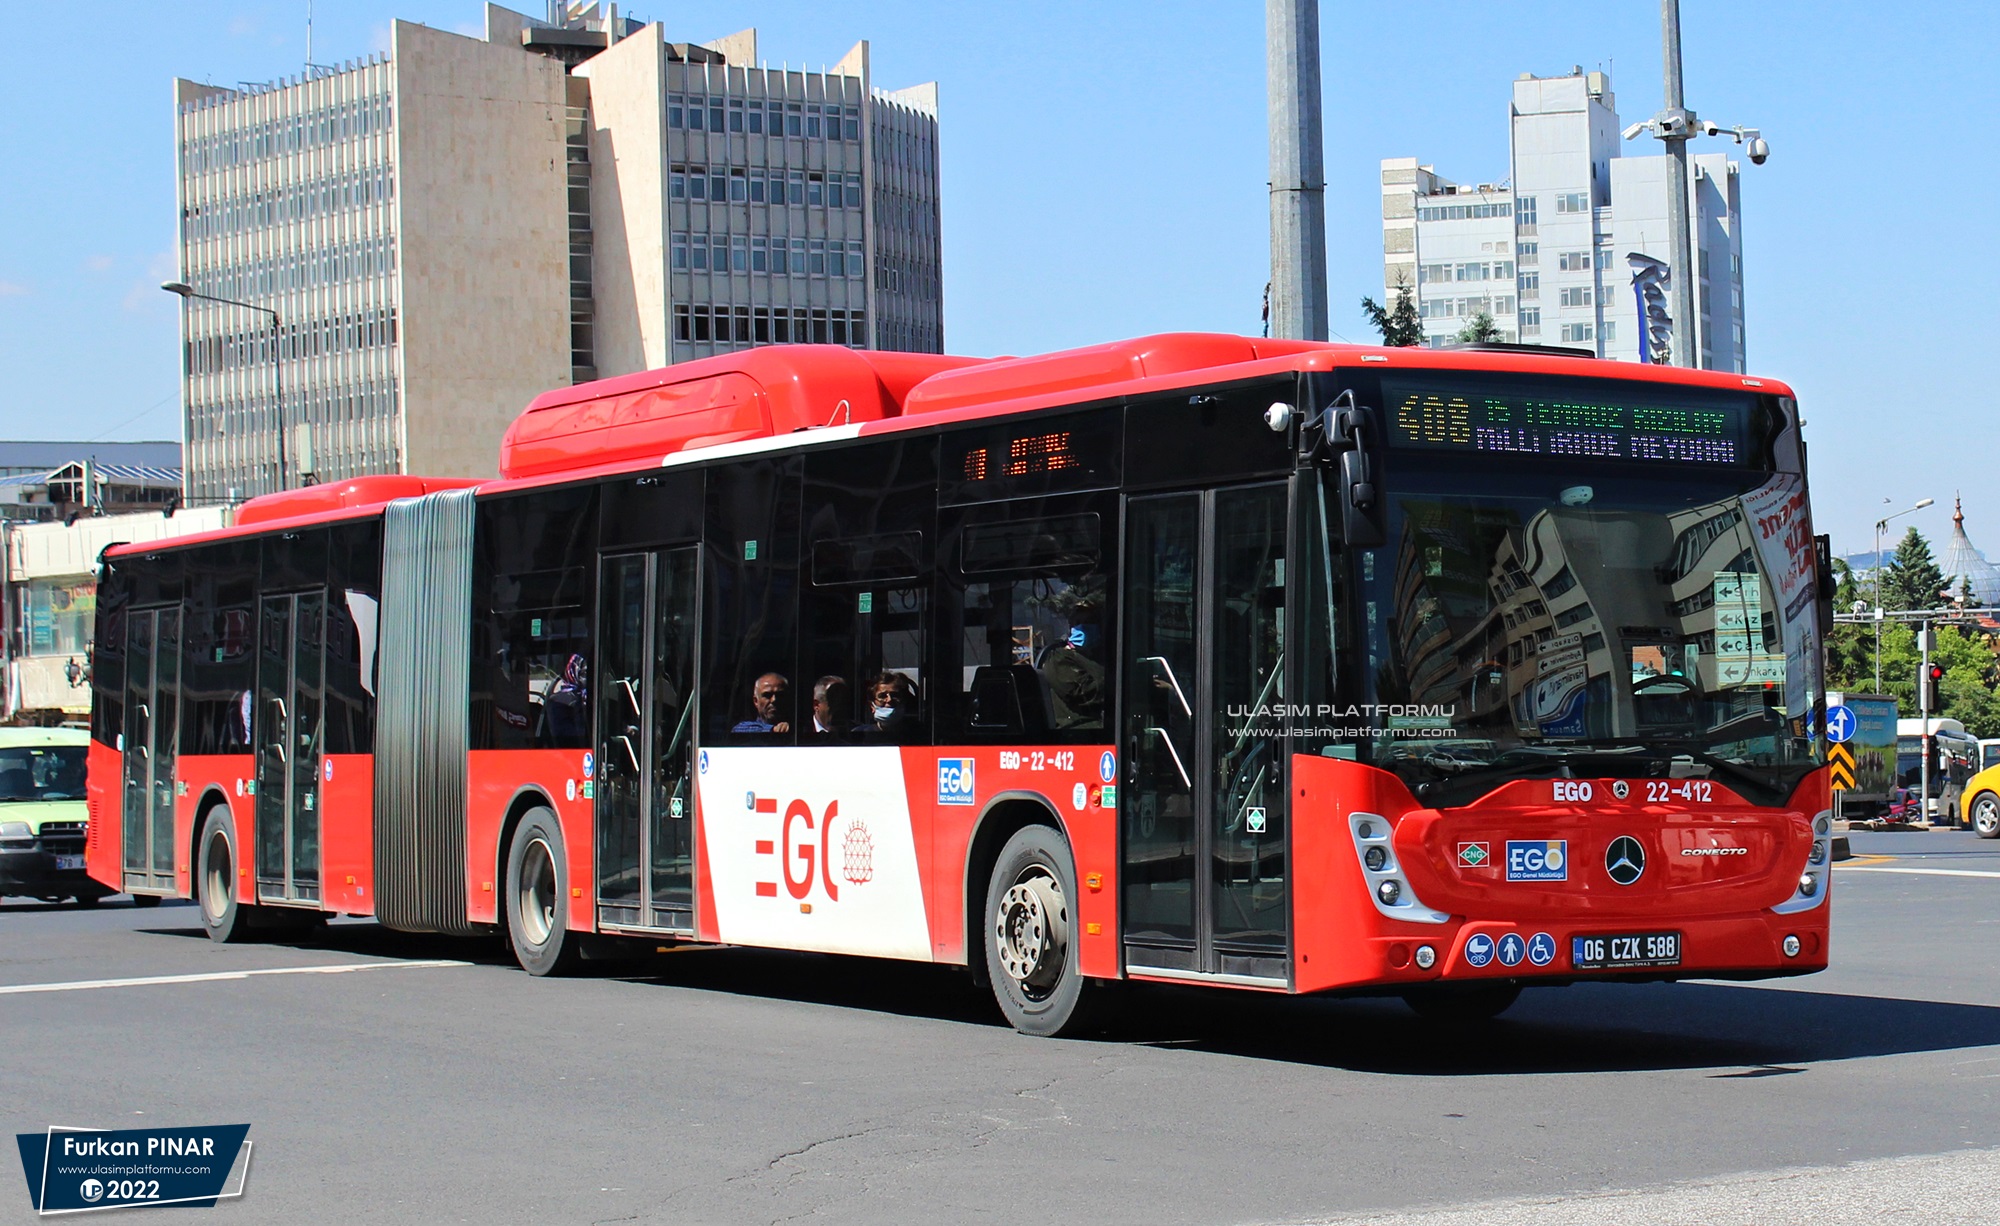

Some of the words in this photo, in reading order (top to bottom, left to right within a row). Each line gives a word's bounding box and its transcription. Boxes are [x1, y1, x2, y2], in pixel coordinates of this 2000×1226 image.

[1399, 394, 1471, 443] 408
[940, 767, 972, 793] EGO
[1553, 782, 1592, 801] EGO
[1646, 782, 1712, 802] 22-412
[1464, 850, 1483, 859] CNG
[1510, 848, 1563, 871] EGO
[1681, 848, 1747, 857] CONECTO
[1584, 940, 1604, 961] 06
[1612, 938, 1641, 959] CZK
[1647, 936, 1675, 958] 588
